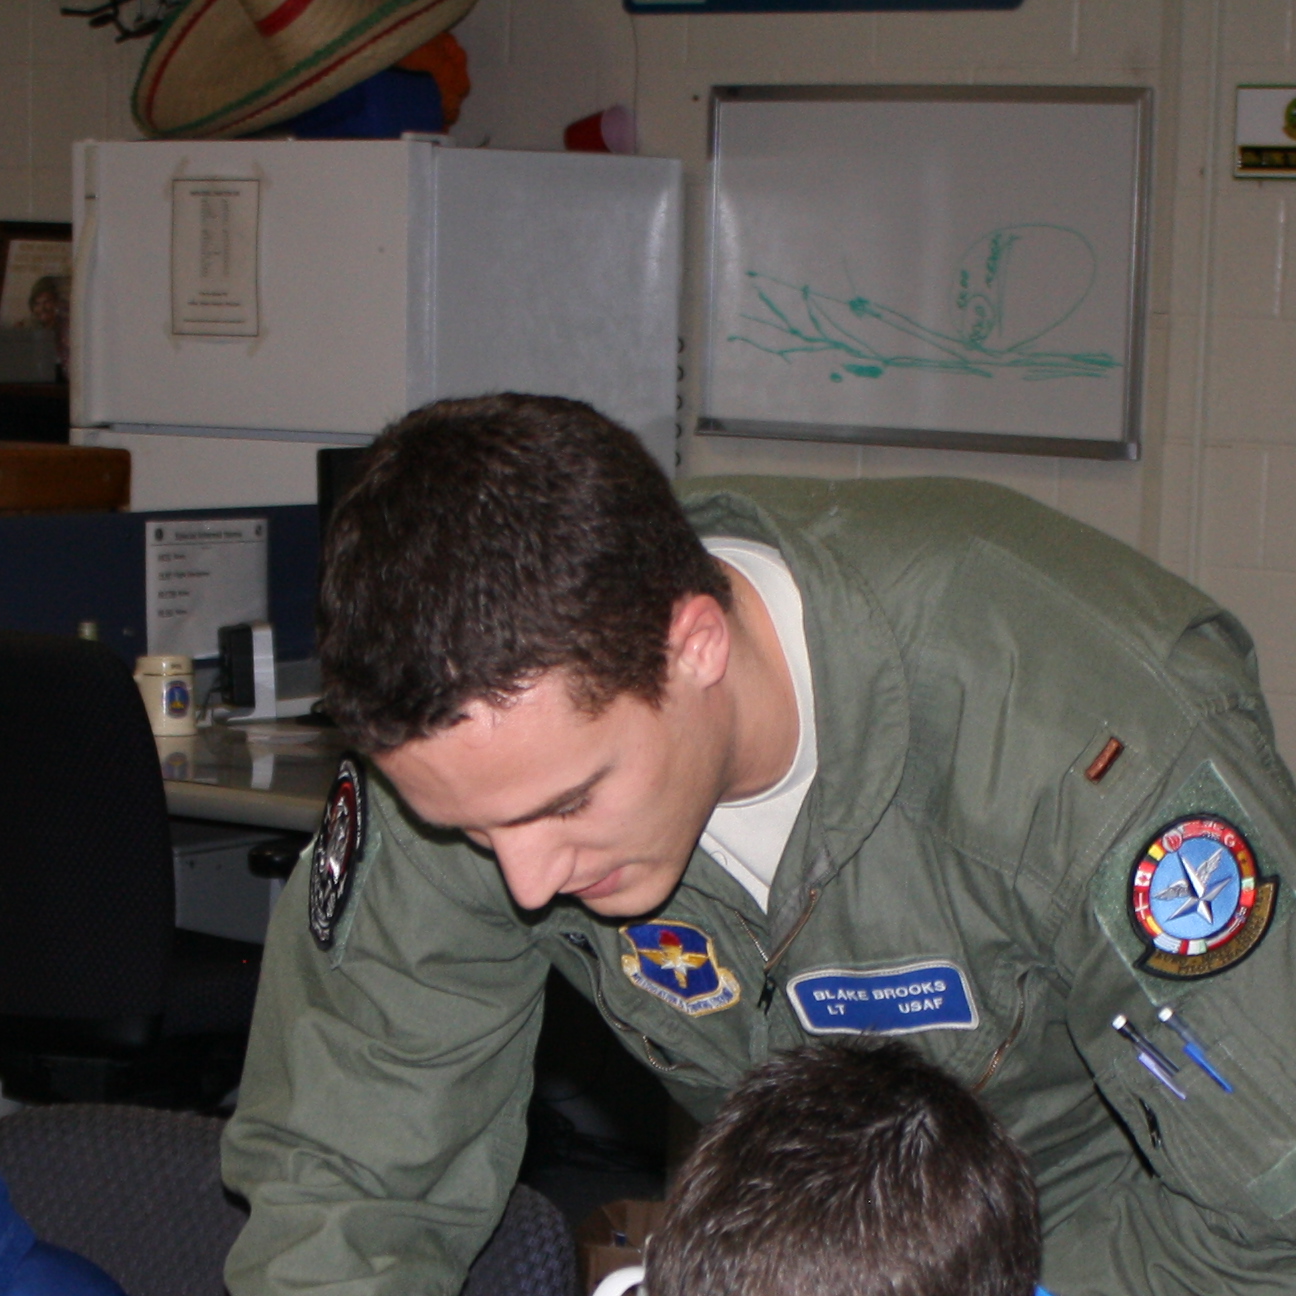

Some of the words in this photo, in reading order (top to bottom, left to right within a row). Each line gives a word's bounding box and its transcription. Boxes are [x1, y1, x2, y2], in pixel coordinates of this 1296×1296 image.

[813, 990, 869, 1001] BLAKE
[872, 980, 946, 1000] BROOKS
[827, 1004, 845, 1015] LT
[898, 998, 943, 1014] USAF
